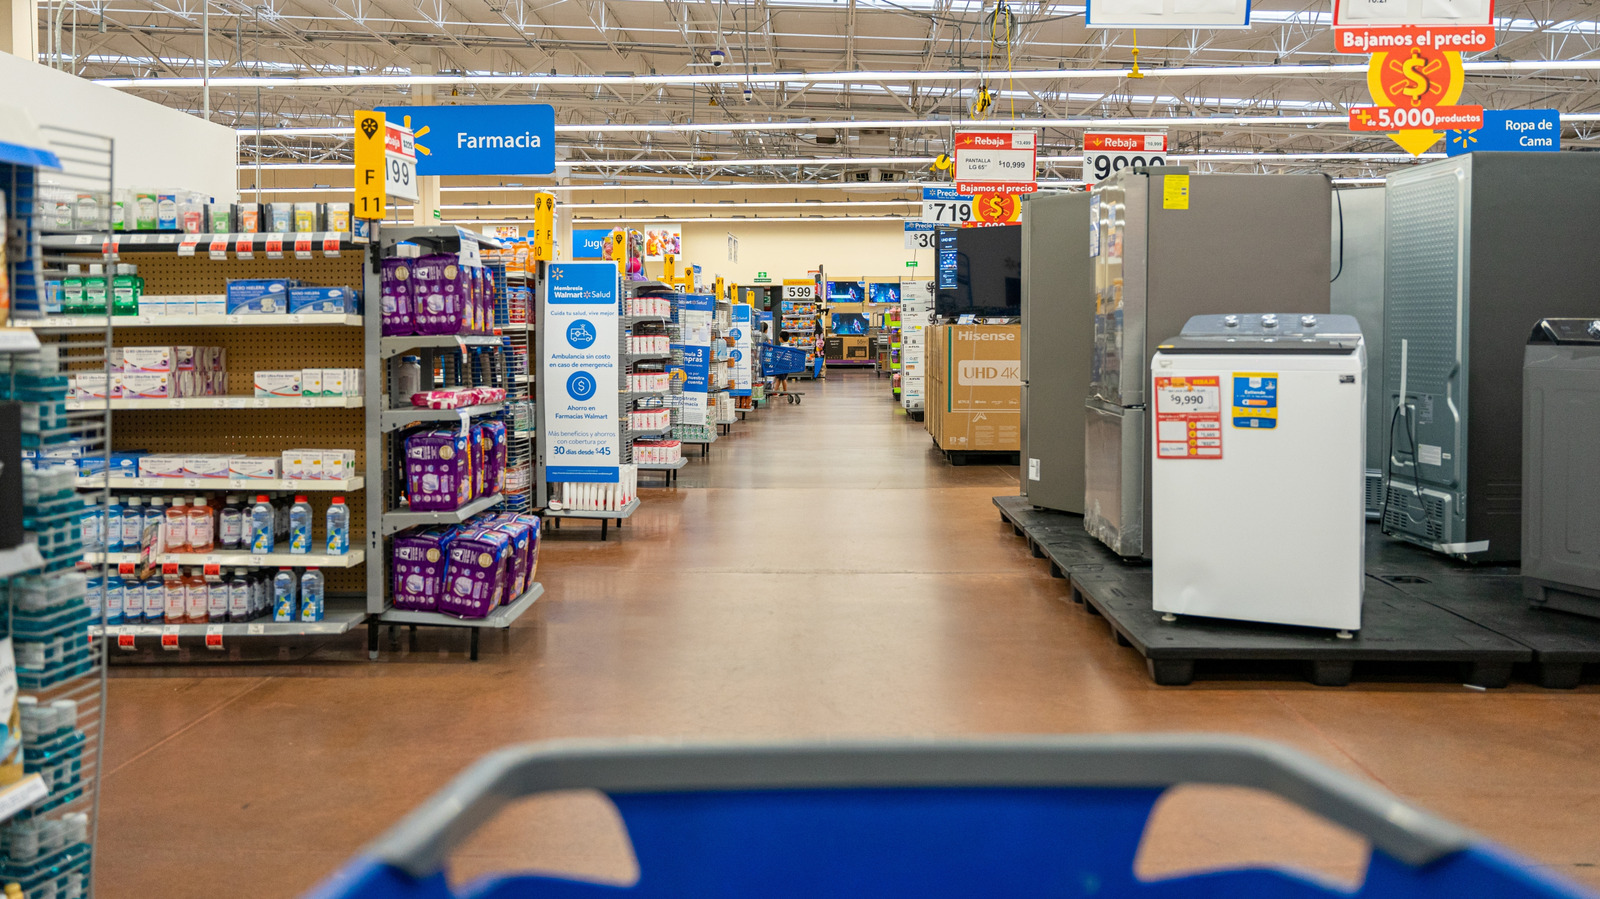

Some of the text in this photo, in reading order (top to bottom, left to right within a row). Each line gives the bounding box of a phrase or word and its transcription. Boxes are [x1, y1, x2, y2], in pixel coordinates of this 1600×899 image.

[1343, 30, 1486, 51] Bajamos el precio
[1378, 108, 1435, 128] 5,000
[1435, 114, 1481, 125] productos
[1505, 119, 1553, 133] Ropa de
[457, 131, 541, 149] Farmacia
[974, 136, 1004, 147] Rebaja
[1104, 137, 1137, 150] Rebaja
[1519, 135, 1552, 146] Cama
[365, 169, 375, 185] F
[937, 189, 958, 197] Precio
[960, 184, 1033, 194] Bajamos el precio
[361, 197, 380, 212] 11
[958, 331, 1015, 341] Hisense
[963, 367, 1019, 379] UHD 4K
[1170, 394, 1204, 406] $9,990
[553, 446, 565, 455] 30
[595, 446, 611, 455] $45
